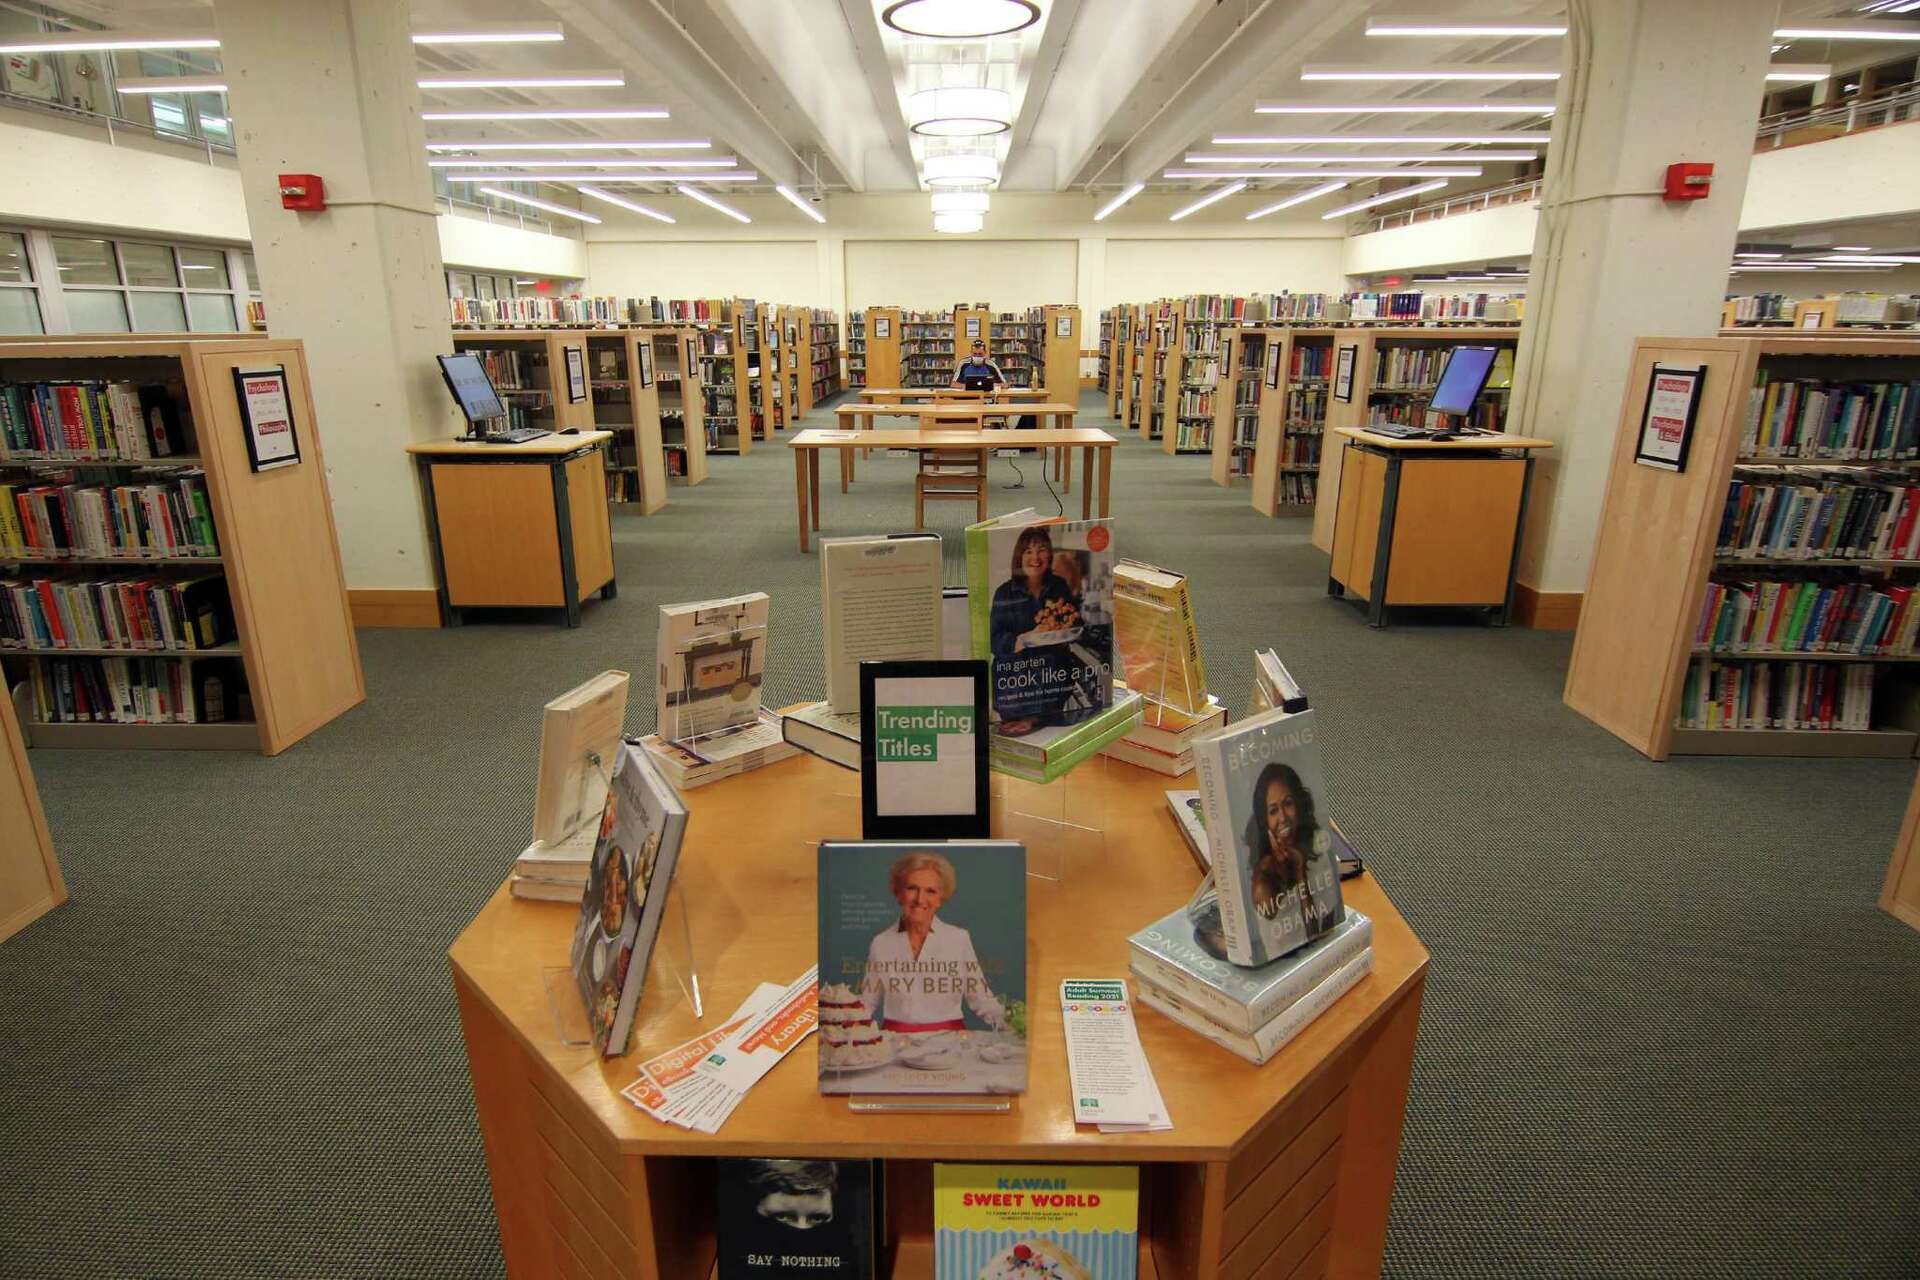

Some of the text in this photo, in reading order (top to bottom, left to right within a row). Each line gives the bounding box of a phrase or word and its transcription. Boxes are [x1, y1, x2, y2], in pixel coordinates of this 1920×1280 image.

[997, 657, 1045, 672] ina garten
[997, 662, 1110, 690] cook like a pro
[879, 708, 972, 734] Trending
[879, 737, 932, 756] Titles
[1228, 726, 1314, 772] BECOMING
[1256, 871, 1333, 919] MICHELLE
[1271, 903, 1330, 939] OBAMA
[855, 976, 992, 994] MARY BERRY
[771, 1008, 818, 1047] Library
[649, 1041, 709, 1075] Digital
[997, 1177, 1067, 1190] KAWAII
[963, 1192, 1101, 1208] SWEET WORLD
[747, 1253, 840, 1267] SAY NOTHING
